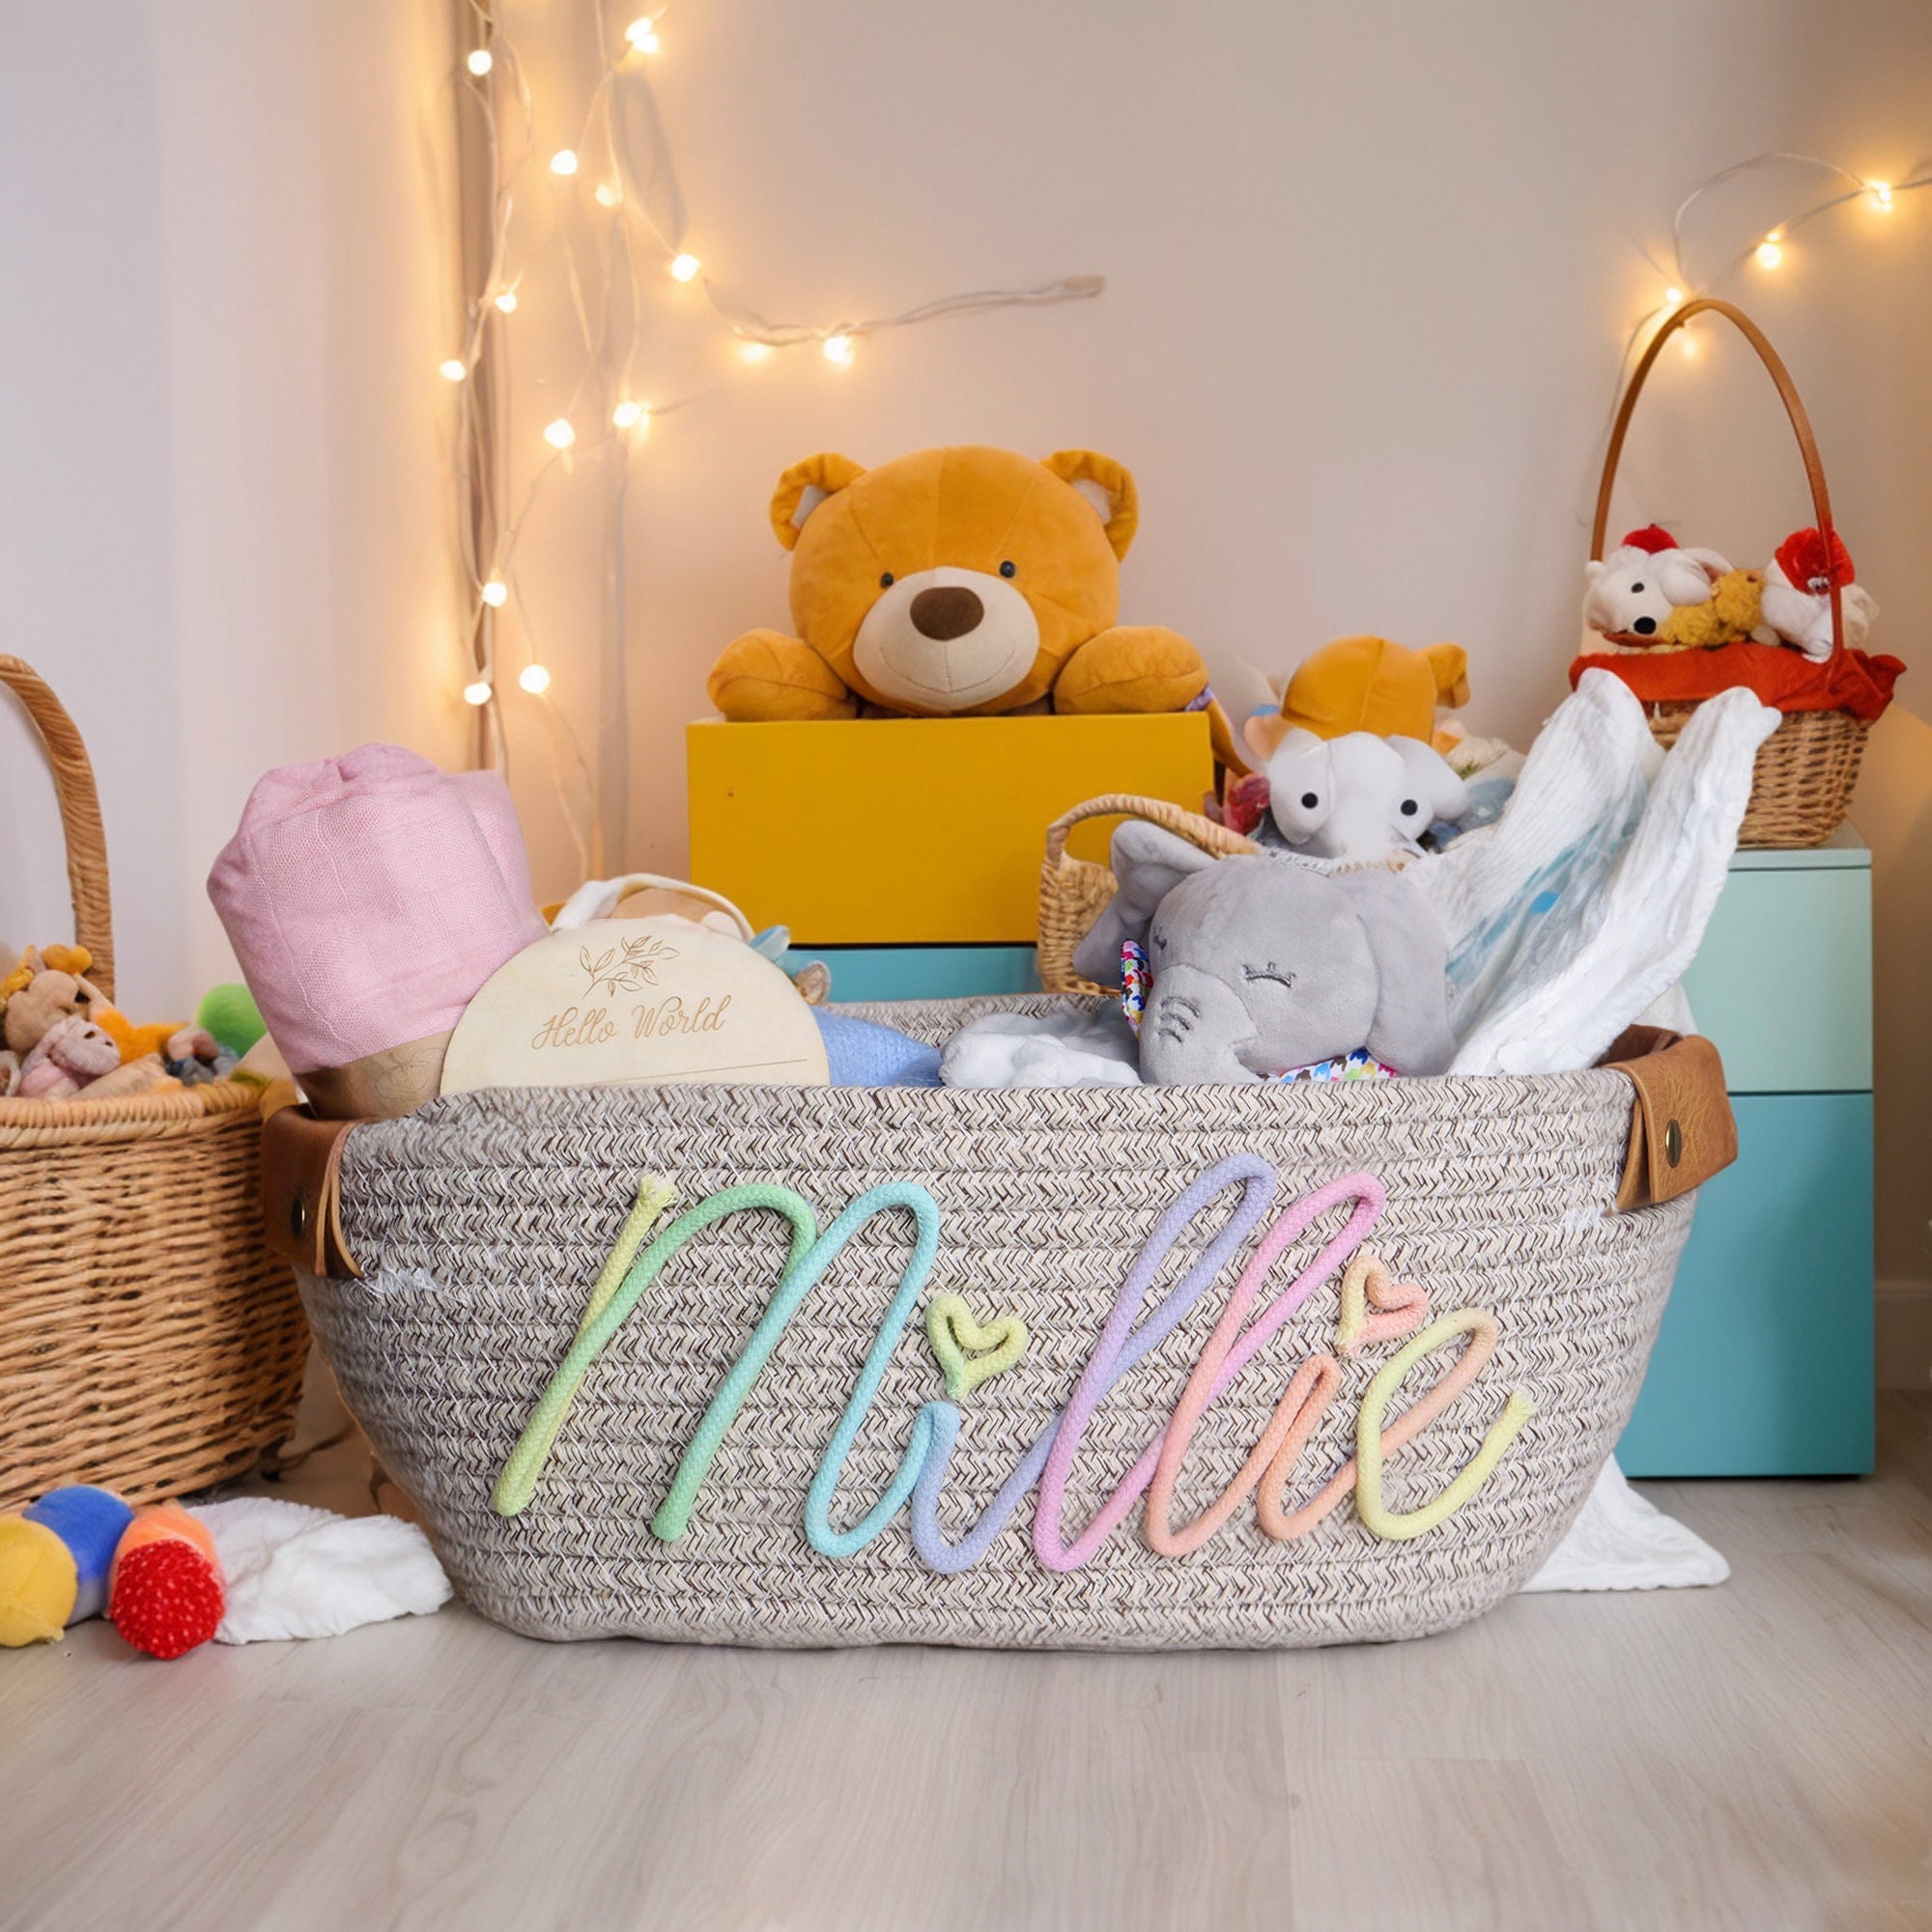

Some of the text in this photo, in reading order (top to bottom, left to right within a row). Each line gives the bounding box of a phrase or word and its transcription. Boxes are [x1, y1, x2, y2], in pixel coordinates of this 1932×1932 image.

[531, 994, 731, 1050] Hello World
[492, 1152, 1533, 1573] Millie
